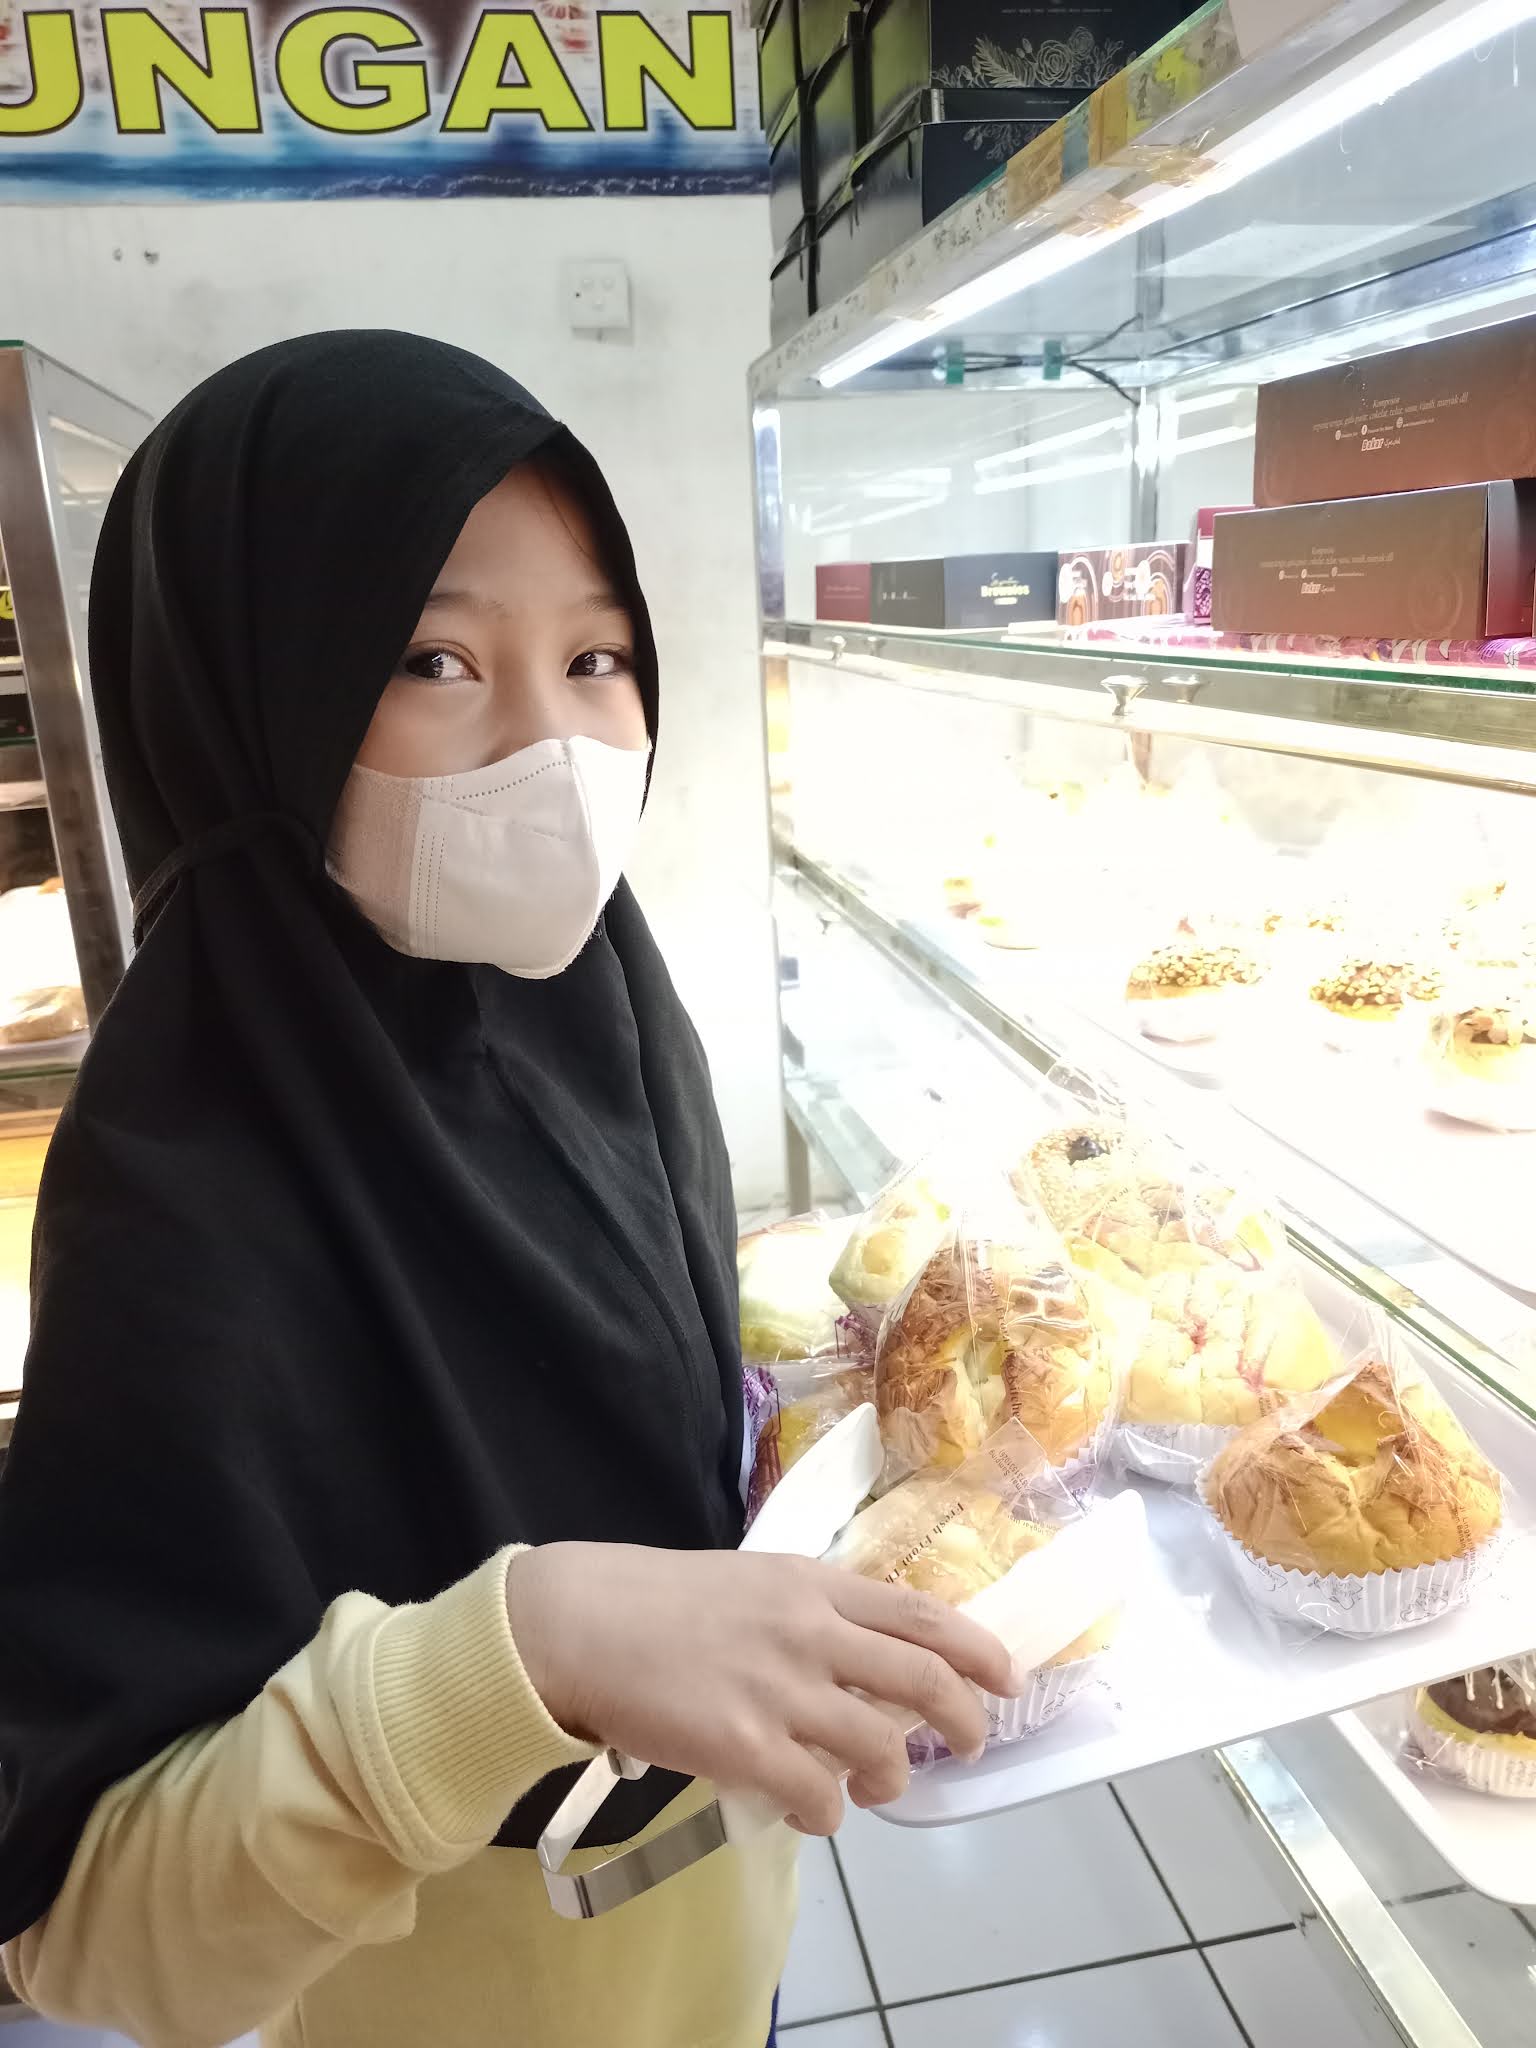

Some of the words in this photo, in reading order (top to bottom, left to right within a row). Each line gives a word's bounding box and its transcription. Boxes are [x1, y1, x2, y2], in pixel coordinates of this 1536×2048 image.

[988, 1449, 1011, 1477] Samping
[997, 1448, 1031, 1487] 5731531026)
[933, 1502, 964, 1535] Fresh
[902, 1534, 933, 1567] From
[884, 1568, 901, 1584] Th
